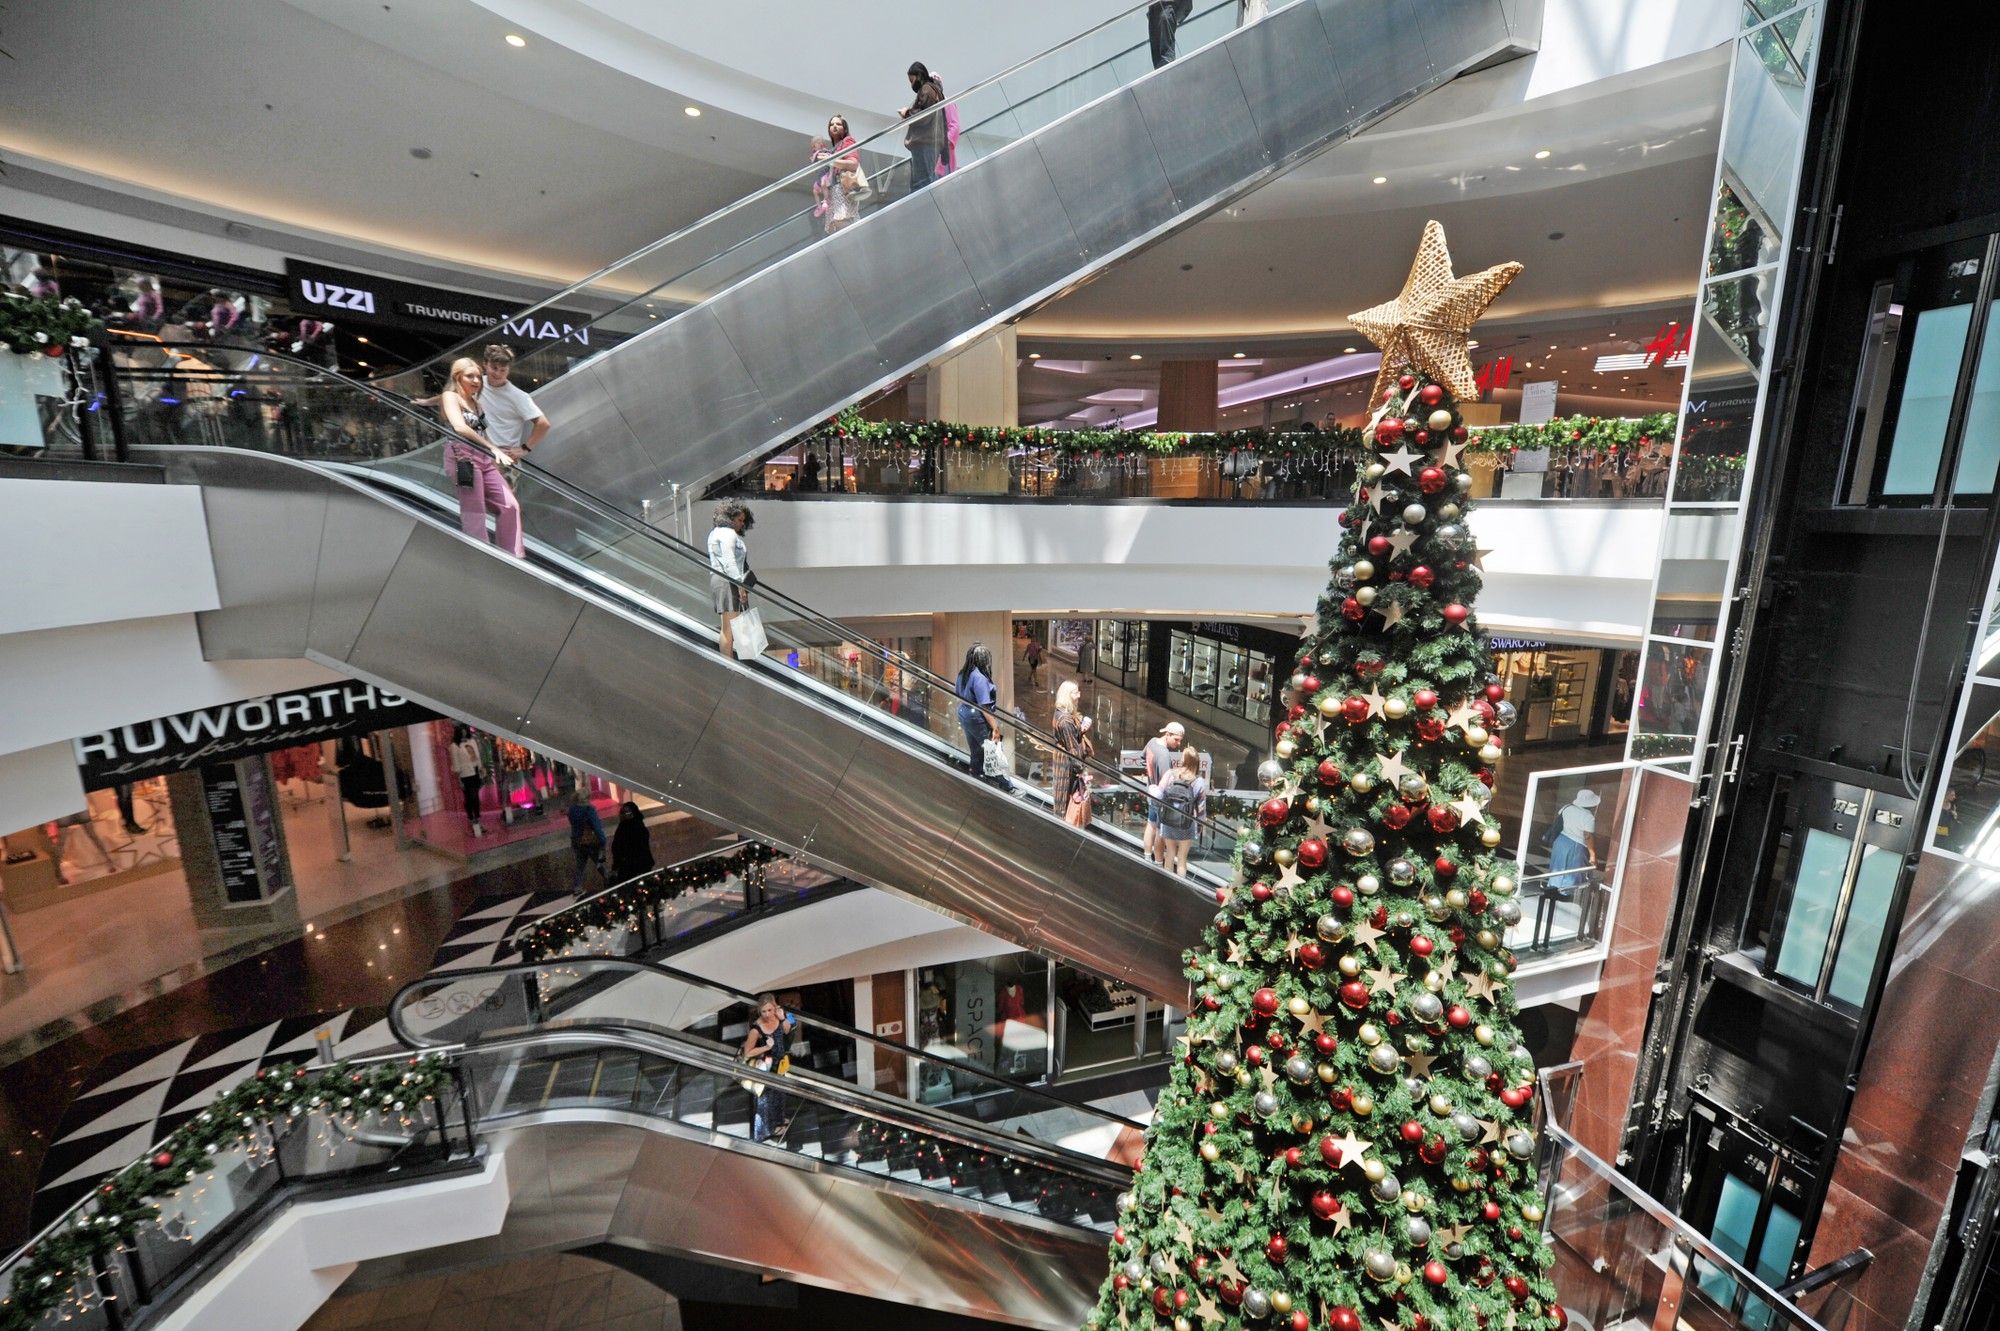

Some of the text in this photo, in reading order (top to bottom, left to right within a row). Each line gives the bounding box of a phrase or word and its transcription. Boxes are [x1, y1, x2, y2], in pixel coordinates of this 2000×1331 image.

[301, 279, 375, 313] UZZI
[406, 303, 589, 345] TRUWORTHS MAN
[967, 997, 984, 1061] SPACE
